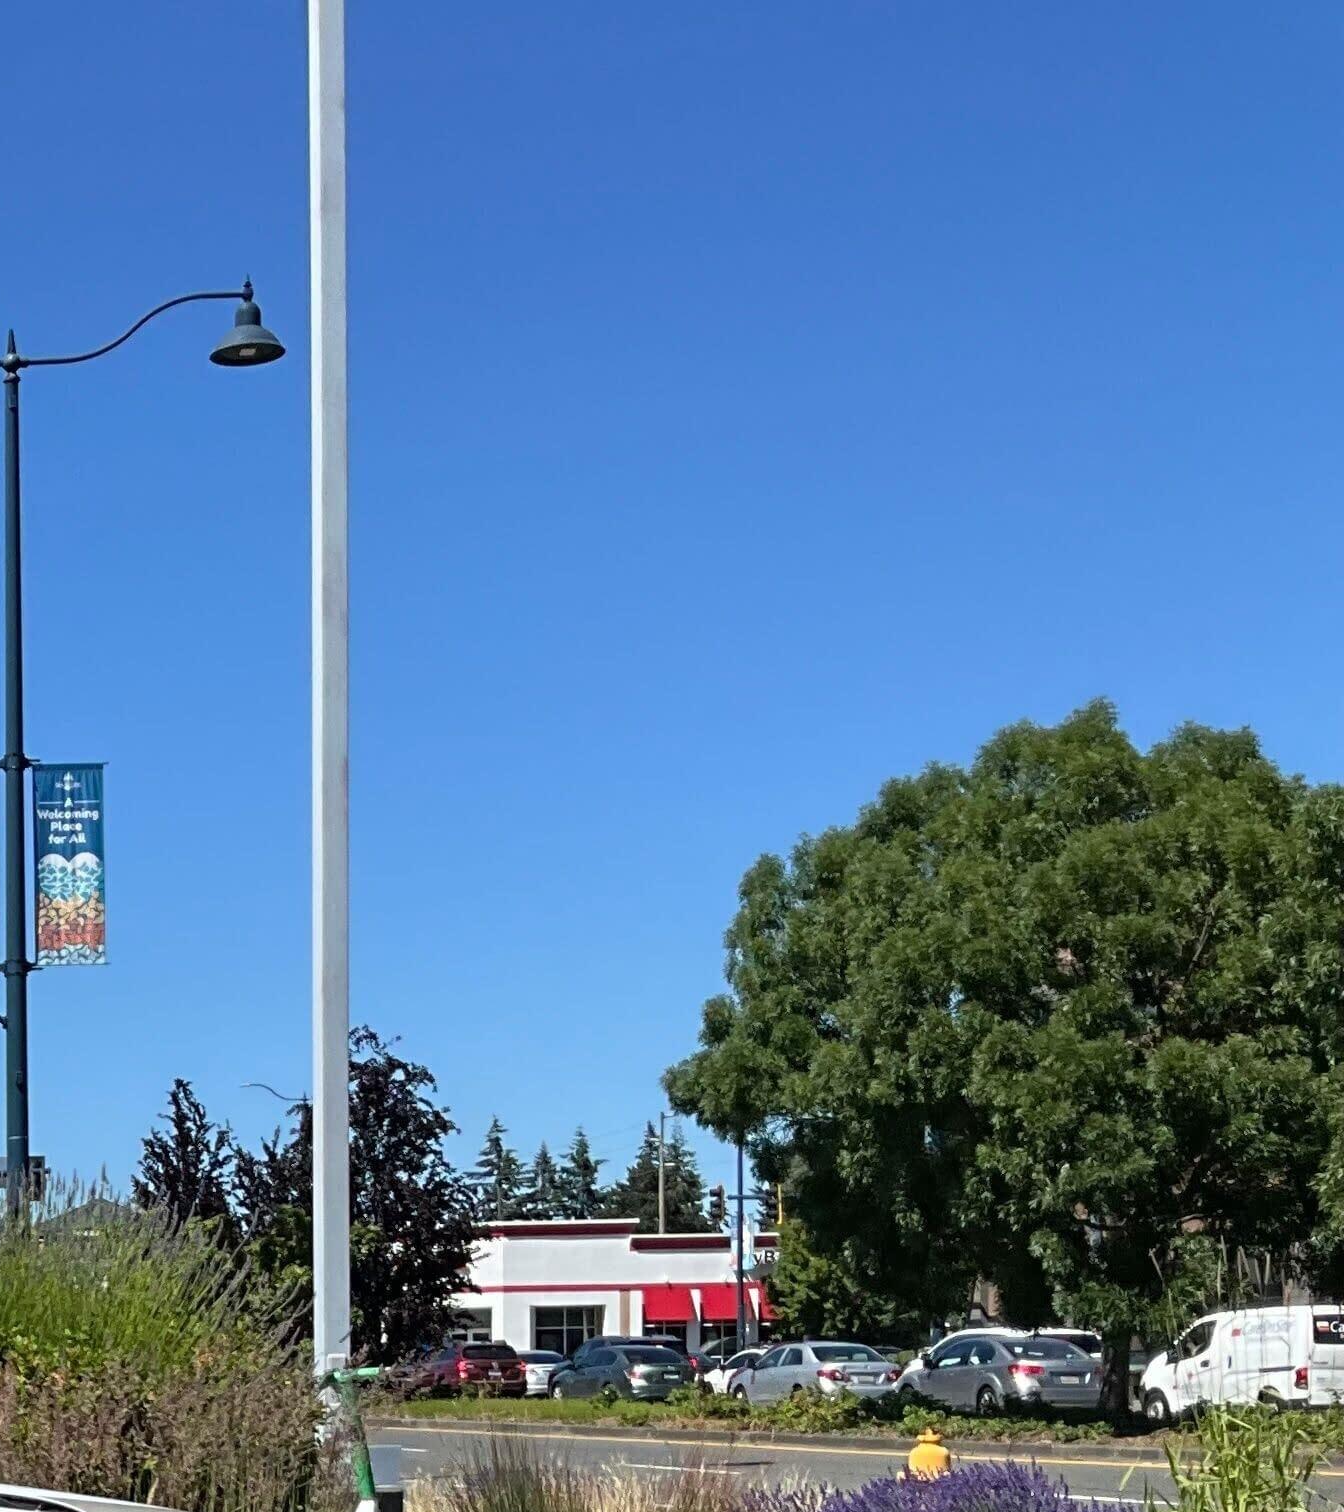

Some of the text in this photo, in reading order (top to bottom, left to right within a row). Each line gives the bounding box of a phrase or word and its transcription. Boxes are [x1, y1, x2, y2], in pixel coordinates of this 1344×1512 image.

[64, 797, 74, 808] A
[36, 807, 100, 821] Welcoming
[50, 821, 83, 832] Place
[48, 832, 87, 845] for All
